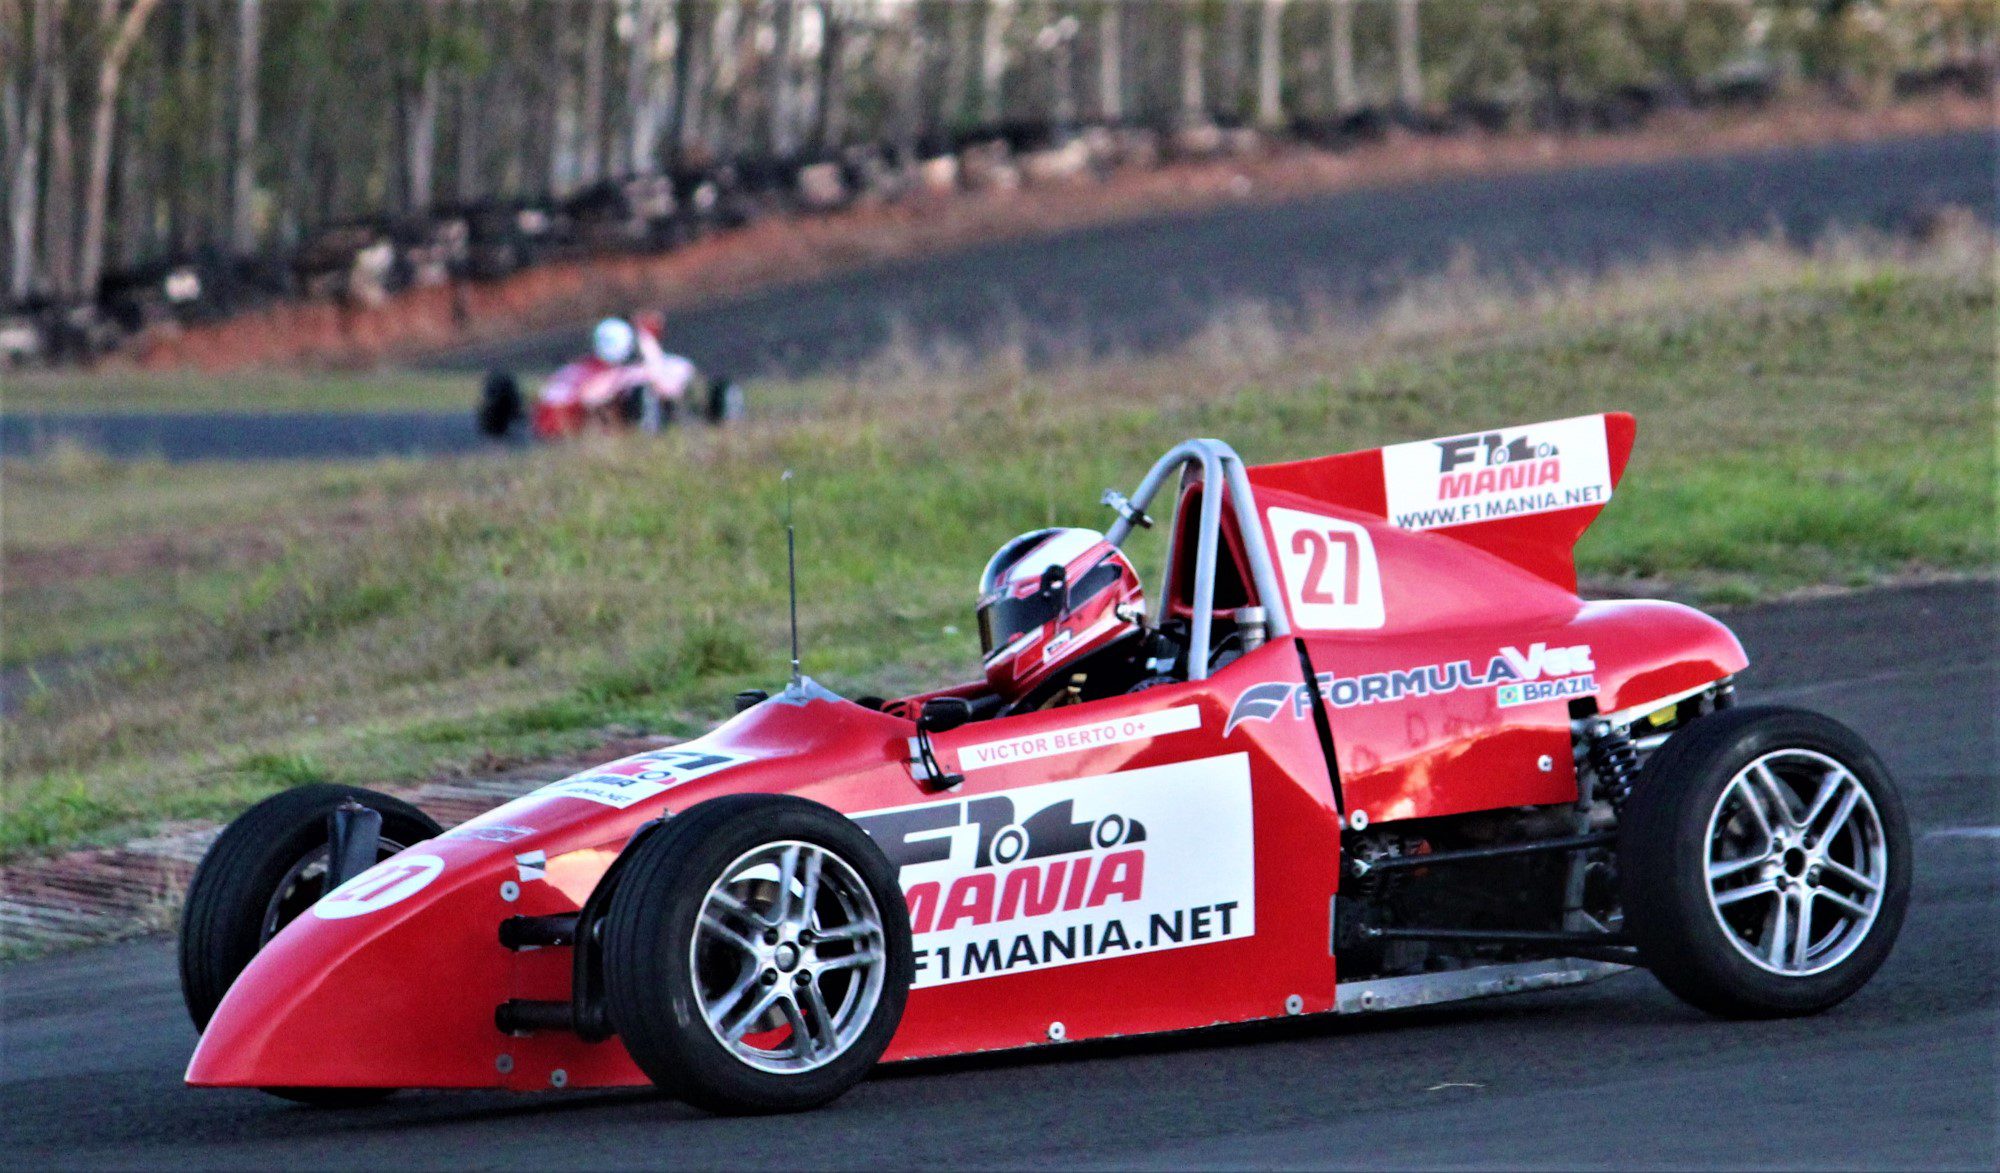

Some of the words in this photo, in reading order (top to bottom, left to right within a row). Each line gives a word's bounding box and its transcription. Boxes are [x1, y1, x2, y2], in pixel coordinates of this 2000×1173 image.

[1438, 458, 1560, 500] MANIA
[1396, 484, 1603, 529] WWW.F1MANIA.NET
[1291, 528, 1360, 605] 27
[1522, 675, 1599, 701] BRAZIL
[977, 738, 1048, 762] VICTOR
[1054, 726, 1117, 749] BERTO
